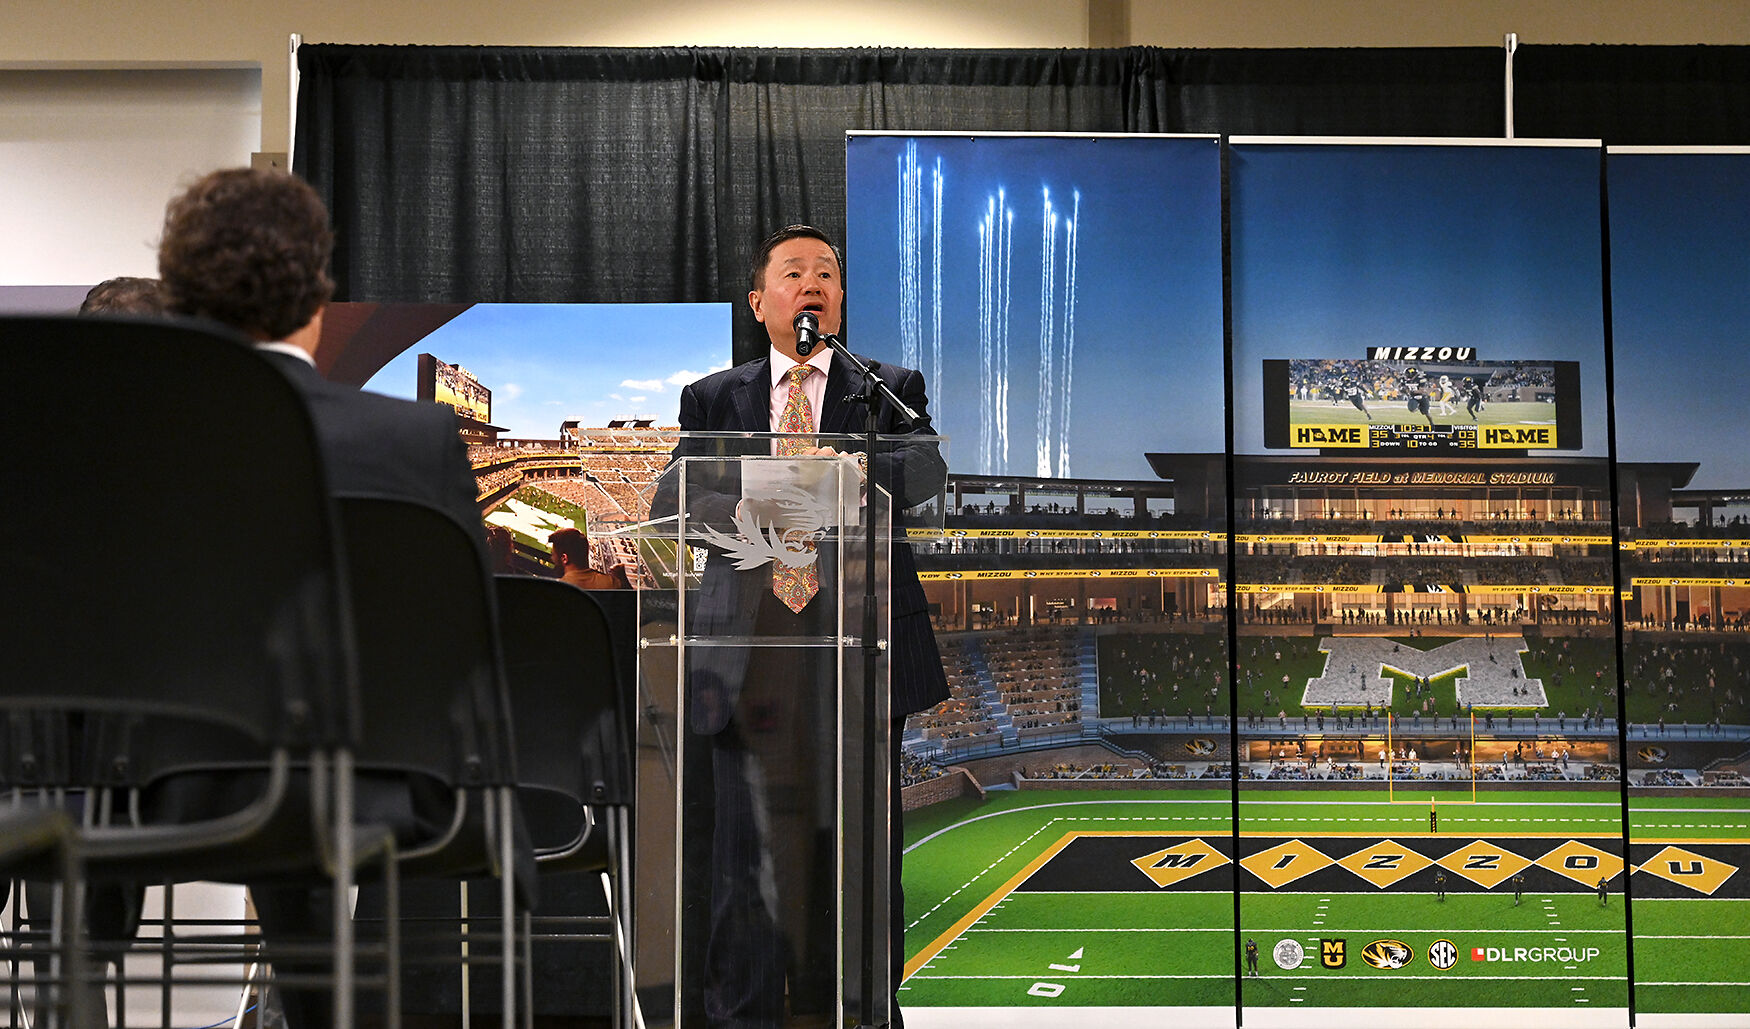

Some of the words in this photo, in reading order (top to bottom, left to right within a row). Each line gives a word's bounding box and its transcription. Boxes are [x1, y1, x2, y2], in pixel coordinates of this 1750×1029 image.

[1374, 347, 1470, 360] MIZZOU
[1372, 430, 1388, 439] 35
[1458, 430, 1475, 438] 03
[1288, 472, 1348, 484] FAUROT
[1350, 472, 1391, 484] FIELD
[1393, 472, 1409, 484] at
[1411, 472, 1486, 484] MEMORIAL
[1489, 472, 1556, 484] STADIUM
[1300, 637, 1550, 710] M
[1430, 941, 1456, 968] SEC
